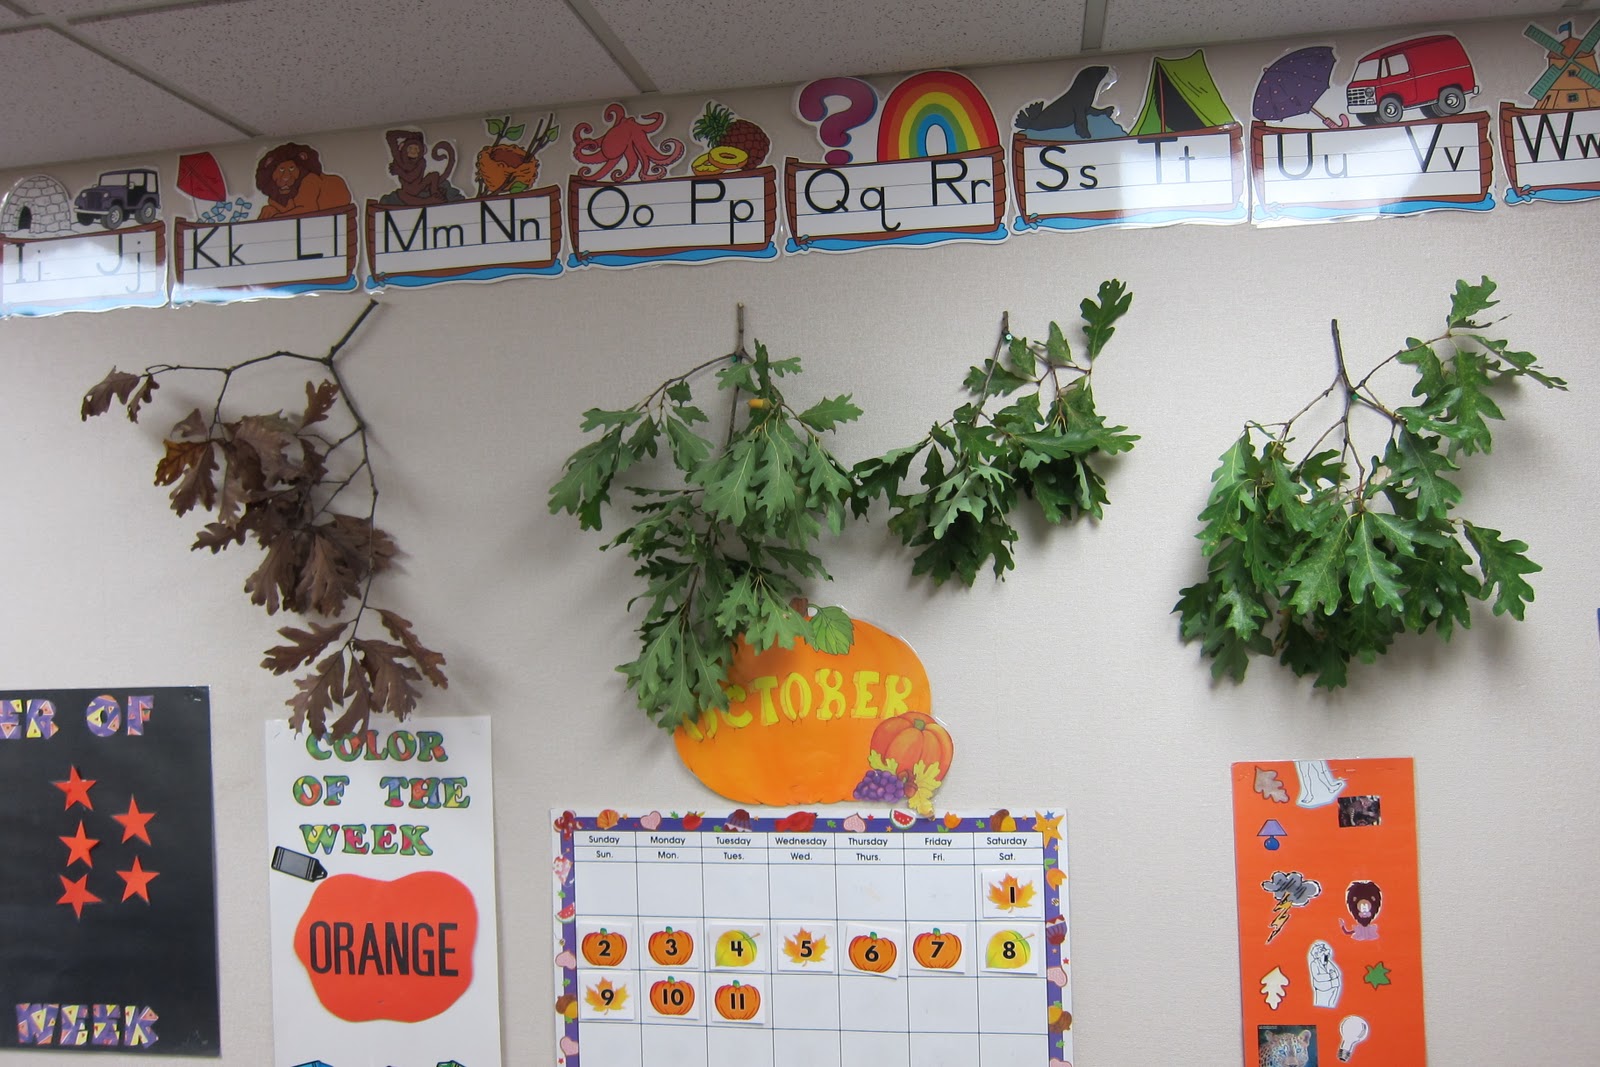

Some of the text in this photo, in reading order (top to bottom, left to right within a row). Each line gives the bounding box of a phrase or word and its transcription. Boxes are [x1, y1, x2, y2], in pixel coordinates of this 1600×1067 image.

[1035, 137, 1196, 192] Ss Tt
[1277, 123, 1464, 180] Uu Vv
[587, 179, 754, 244] Oo Pp
[804, 159, 992, 232] Qq Rr
[193, 214, 339, 269] Kk Ll
[383, 198, 540, 253] Mm Nn
[96, 233, 142, 293] Jj
[86, 694, 155, 738] OF
[305, 729, 449, 763] COLOR
[292, 775, 471, 809] OF THE
[299, 823, 434, 857] WEEK
[588, 835, 1028, 847] Sunday Monday Tuesday Wednesday Thursday Friday Saturday
[596, 850, 1016, 862] Sun. Mon. Tues. Wed. Thurs. Fri. Sat.
[1009, 886, 1016, 904] 1
[309, 920, 460, 977] ORANGE
[598, 938, 1017, 962] 2 3 4 5 6 7 8
[600, 988, 745, 1010] 9 10 11
[15, 1003, 159, 1048] WEEK
